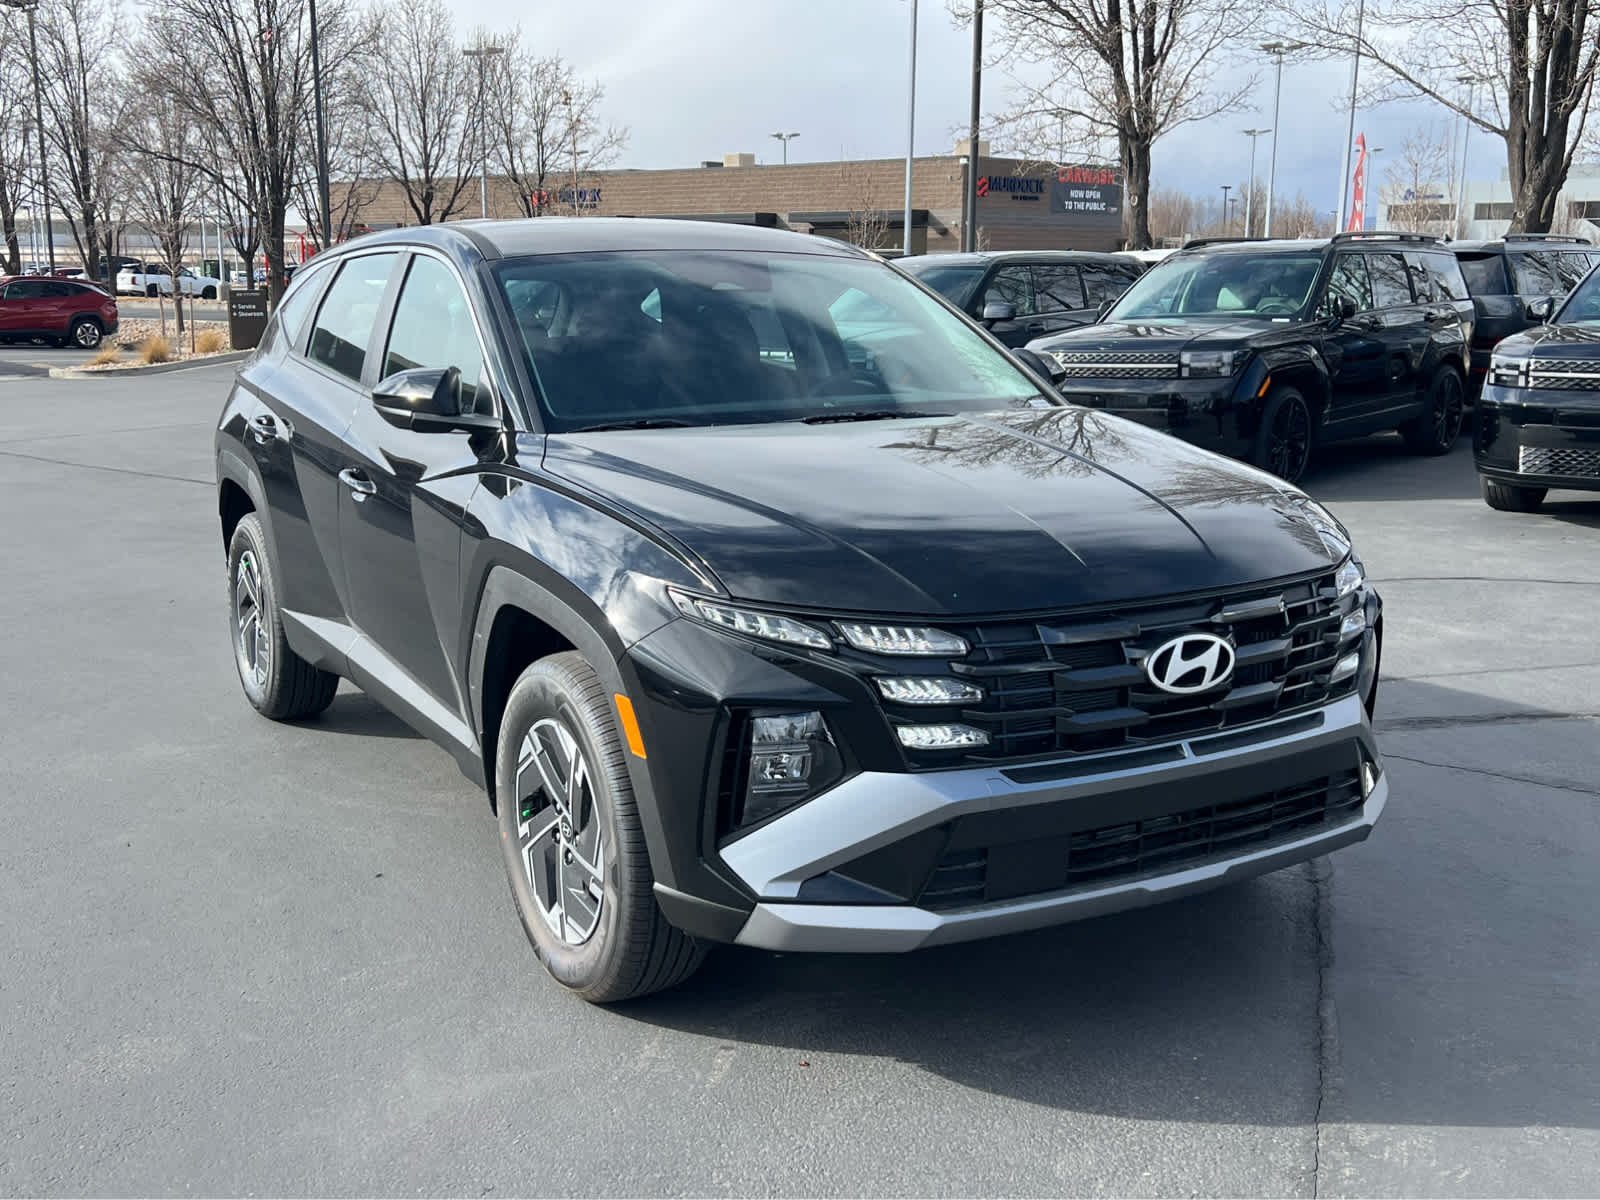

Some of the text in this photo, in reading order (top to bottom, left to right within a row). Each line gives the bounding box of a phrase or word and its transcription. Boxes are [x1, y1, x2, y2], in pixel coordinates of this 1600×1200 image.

[1070, 190, 1101, 199] NOW OPEN
[1065, 201, 1073, 209] TO
[1074, 201, 1085, 210] THE
[1086, 201, 1106, 210] PUBLIC
